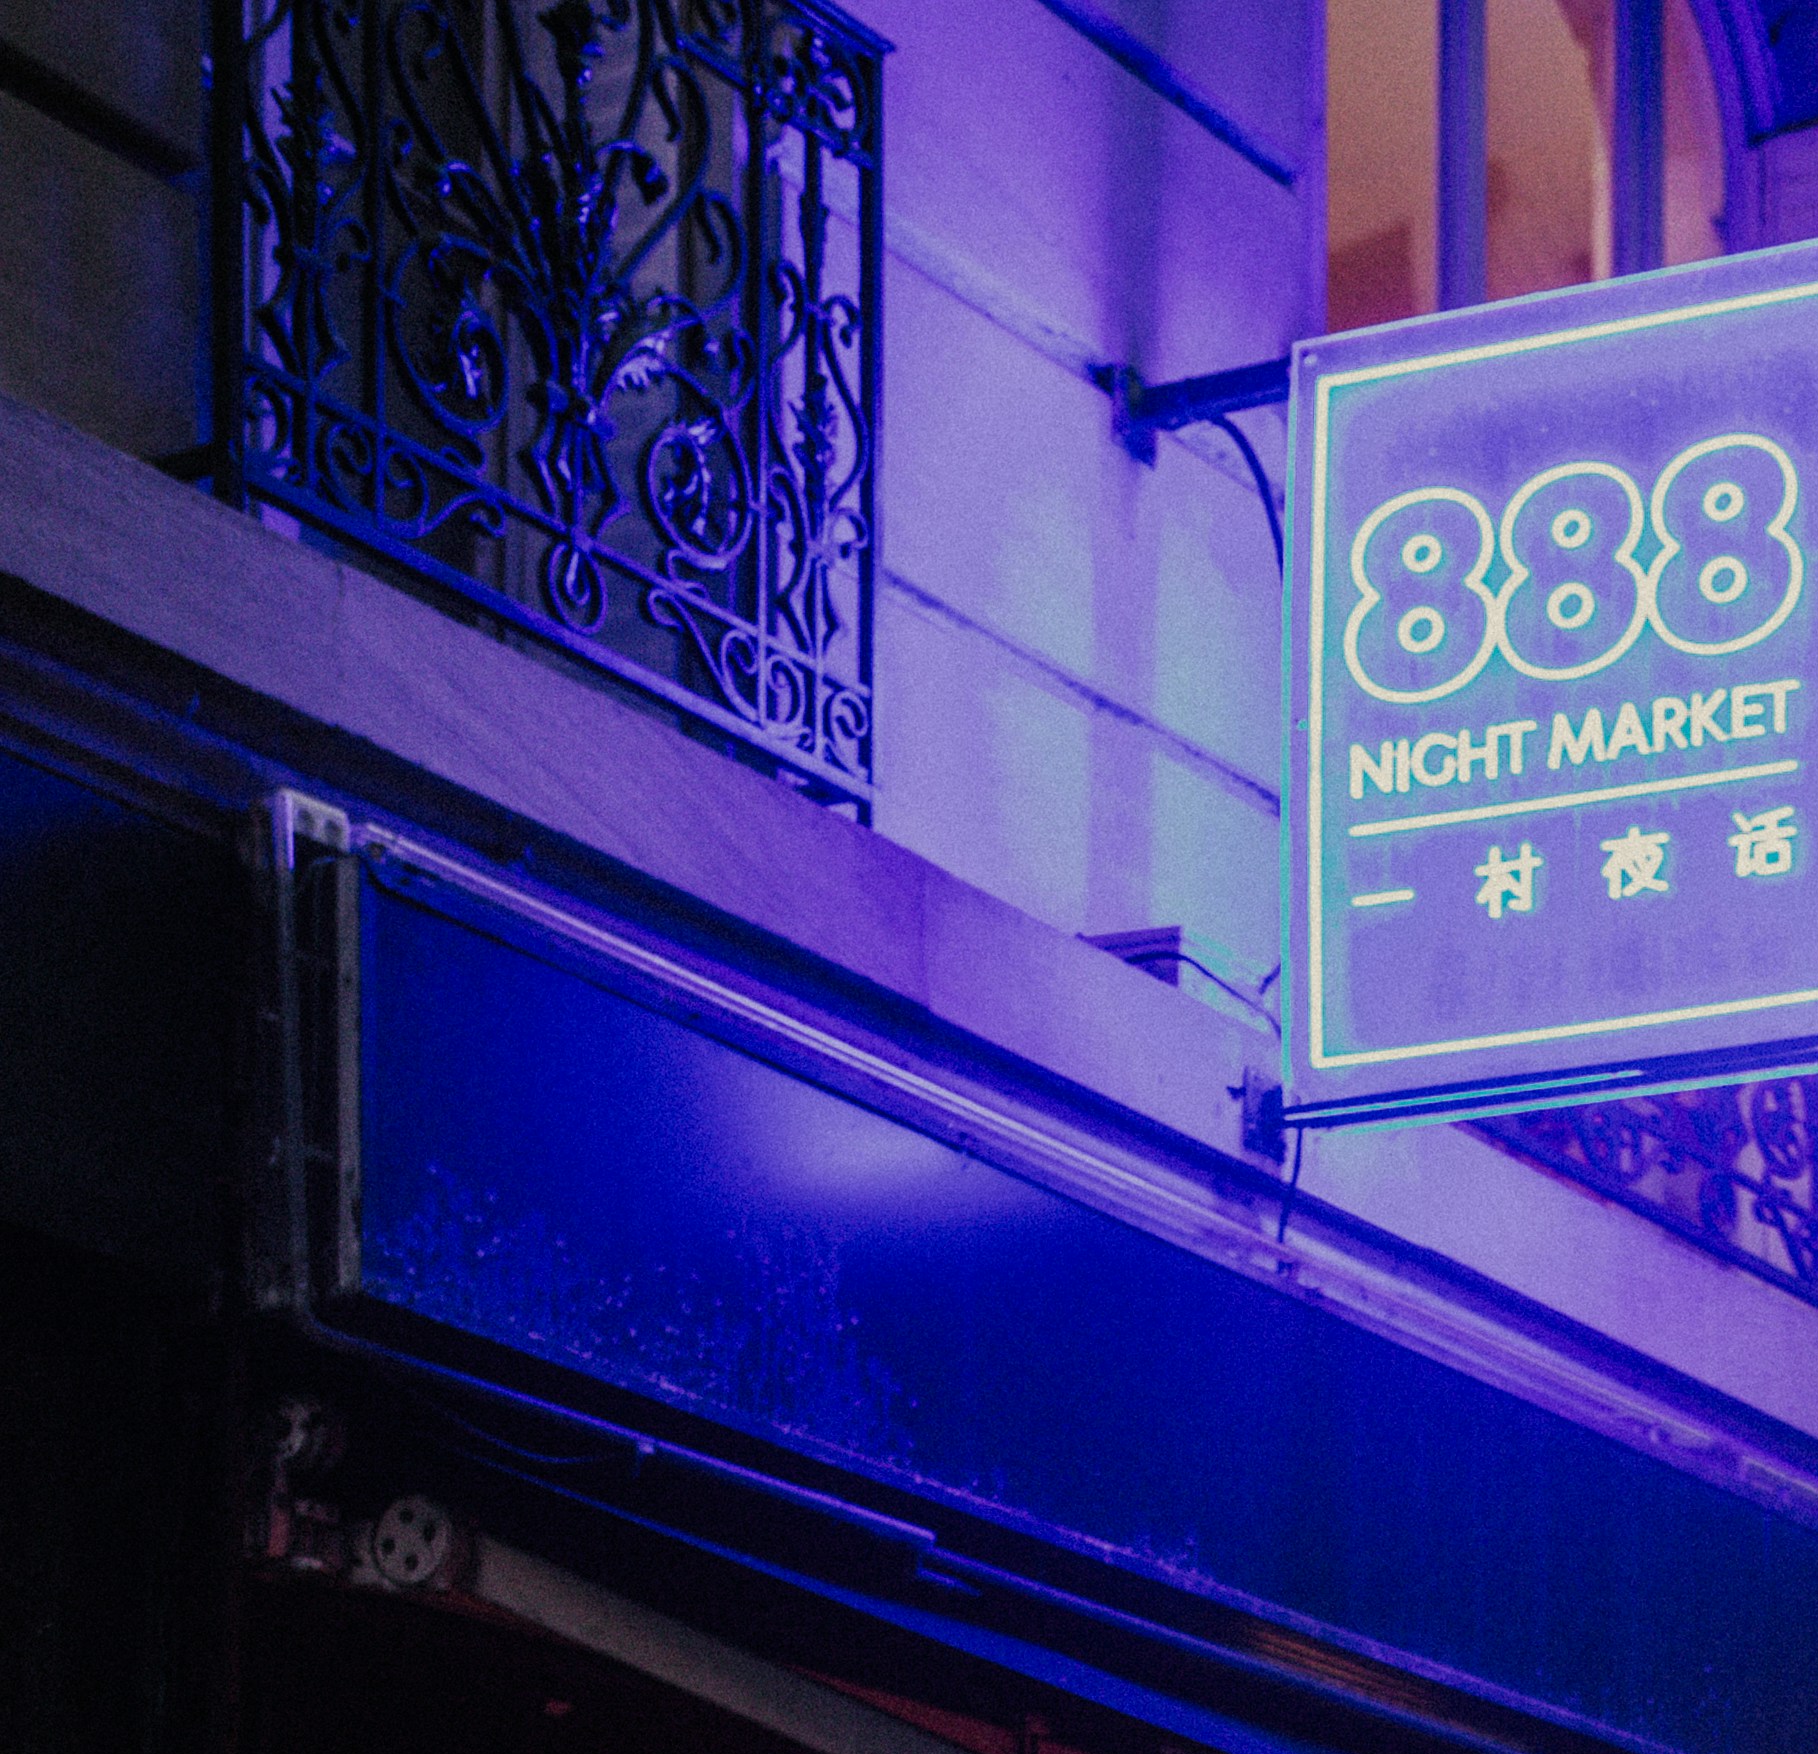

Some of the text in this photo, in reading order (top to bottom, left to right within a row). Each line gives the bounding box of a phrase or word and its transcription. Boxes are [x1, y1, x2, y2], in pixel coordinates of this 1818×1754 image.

[1343, 433, 1803, 704] 888
[1349, 679, 1801, 800] NIGHT MARKET
[1350, 805, 1799, 919] 一村夜话
